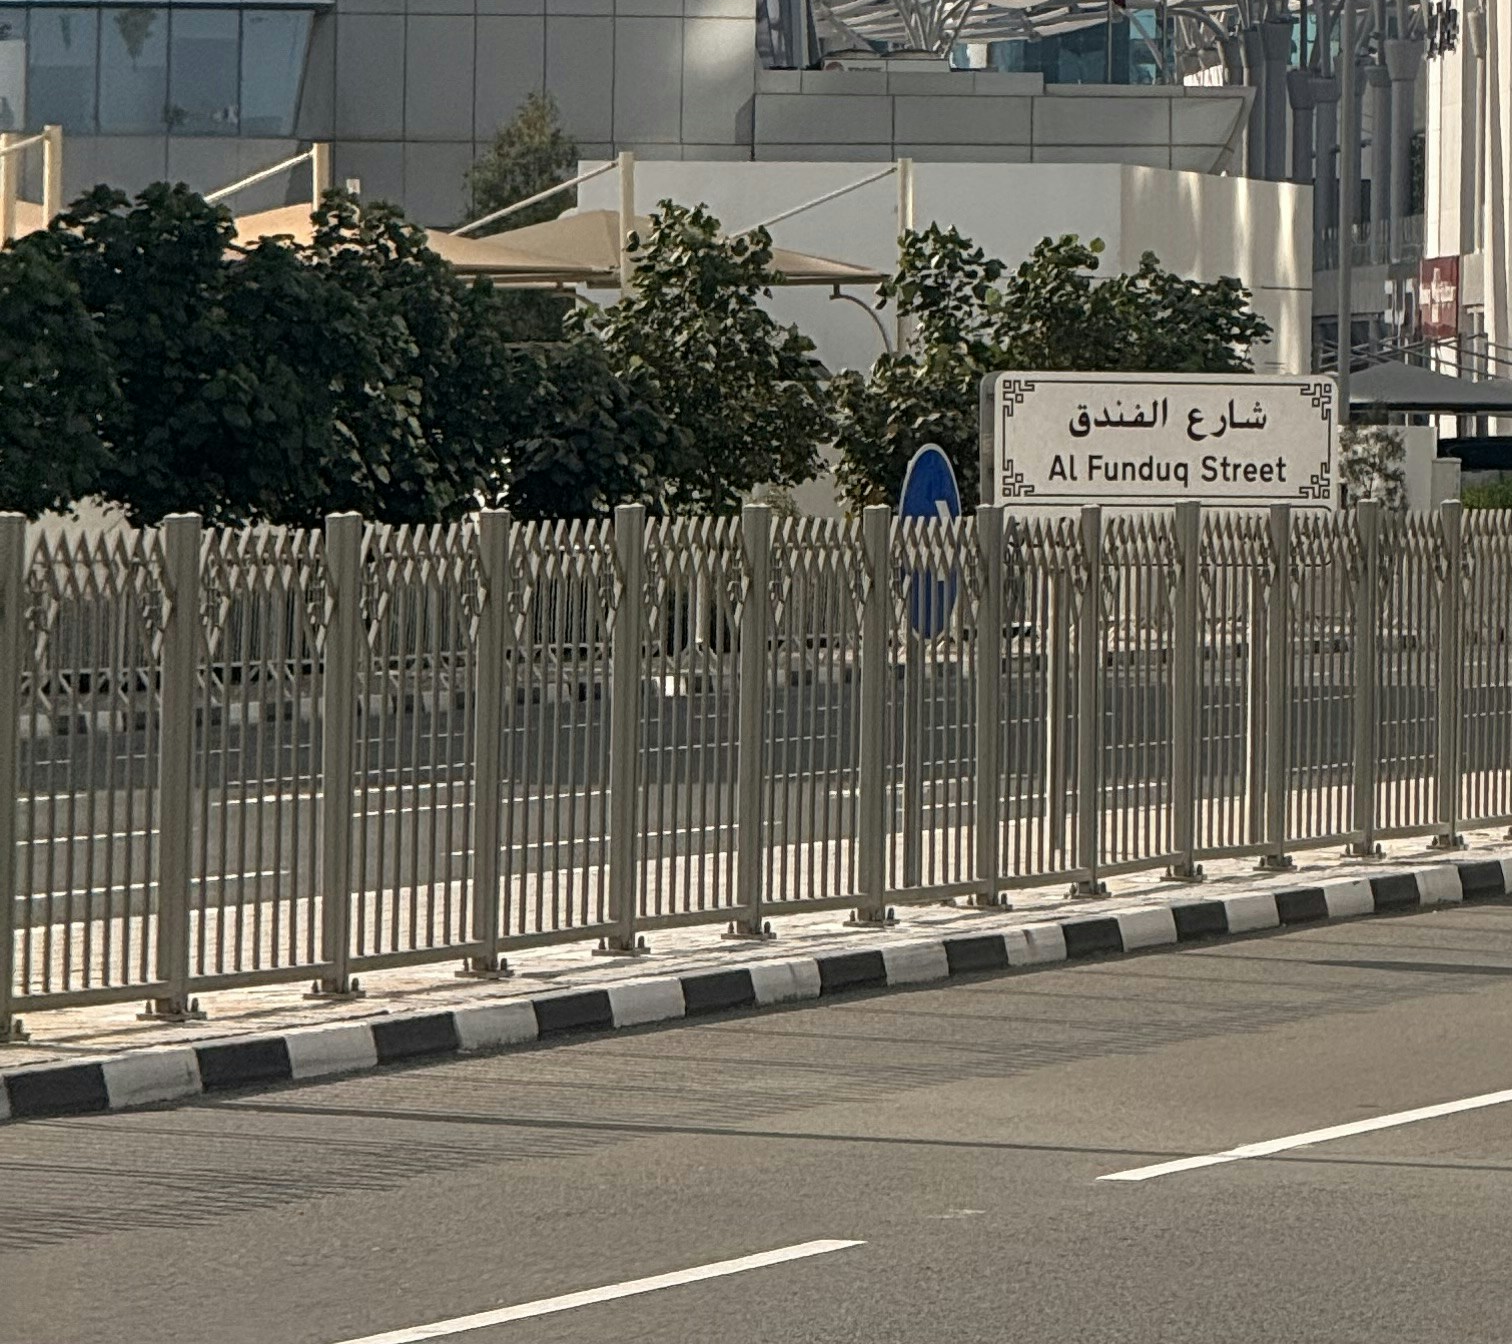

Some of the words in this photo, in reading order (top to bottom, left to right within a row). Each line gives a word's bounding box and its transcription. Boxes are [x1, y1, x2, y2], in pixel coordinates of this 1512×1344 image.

[1069, 397, 1168, 438] الفندق
[1187, 399, 1268, 442] شارع
[1048, 454, 1078, 482] Al
[1088, 454, 1189, 489] Funduq
[1200, 455, 1287, 483] Street
